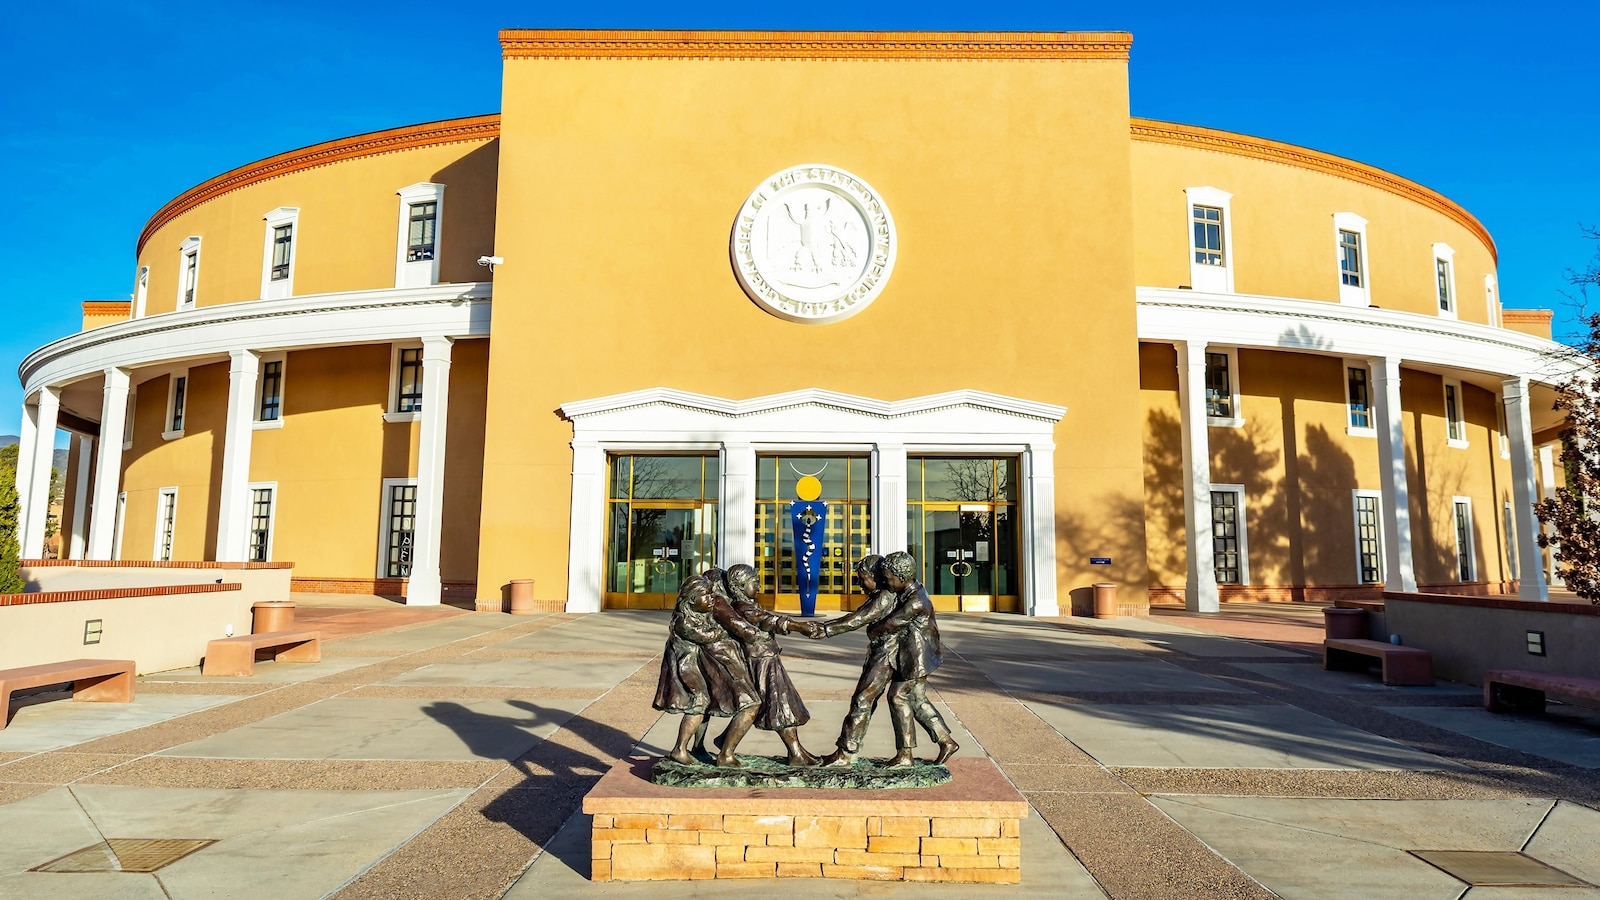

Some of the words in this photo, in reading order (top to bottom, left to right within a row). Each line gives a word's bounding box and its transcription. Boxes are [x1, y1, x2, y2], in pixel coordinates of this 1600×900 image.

[771, 170, 801, 191] THE
[809, 168, 861, 192] STATE
[861, 190, 880, 212] OF
[738, 211, 758, 253] SEAL
[873, 212, 889, 247] NEW
[849, 253, 887, 303] MEXICO
